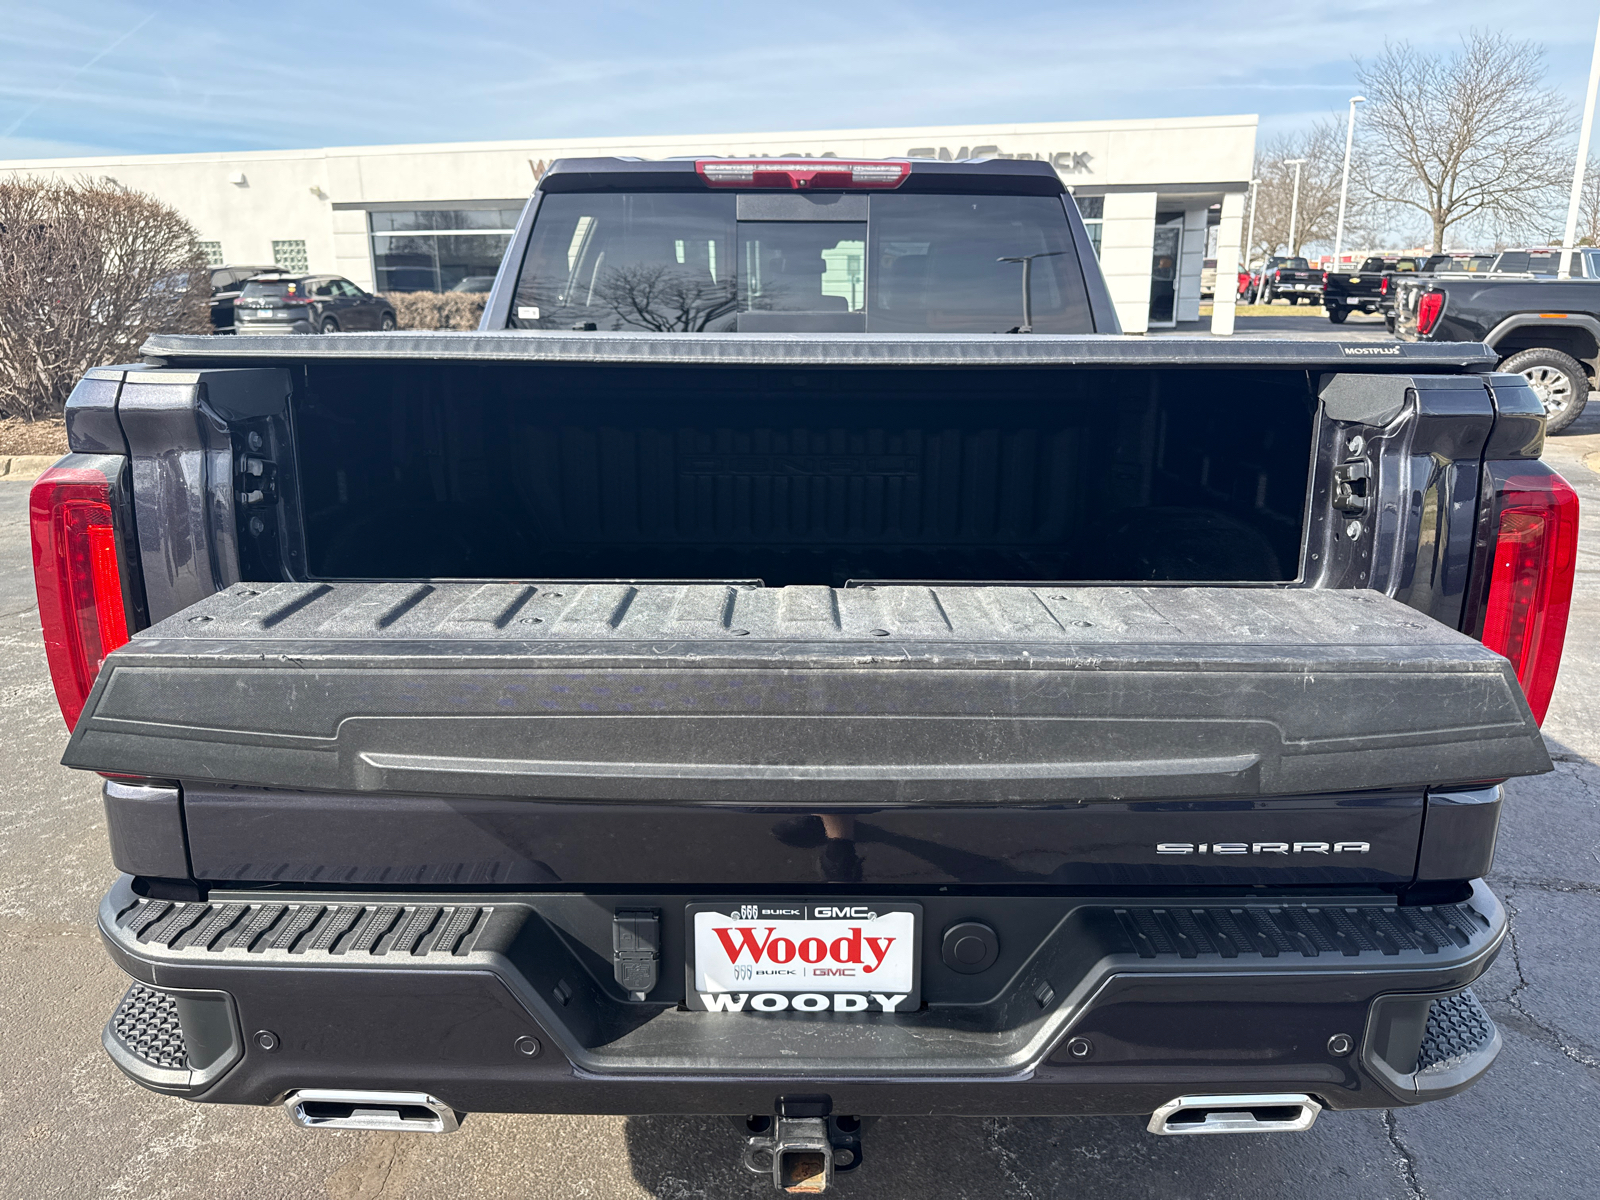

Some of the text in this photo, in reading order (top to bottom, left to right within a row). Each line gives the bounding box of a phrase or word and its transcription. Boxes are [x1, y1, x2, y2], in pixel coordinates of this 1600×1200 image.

[1344, 346, 1400, 355] MOSTPLUS
[1156, 841, 1371, 855] SIERRA
[814, 906, 869, 918] GMC
[711, 927, 896, 973] Woody
[812, 968, 856, 977] GMC
[699, 993, 908, 1013] WOODY
